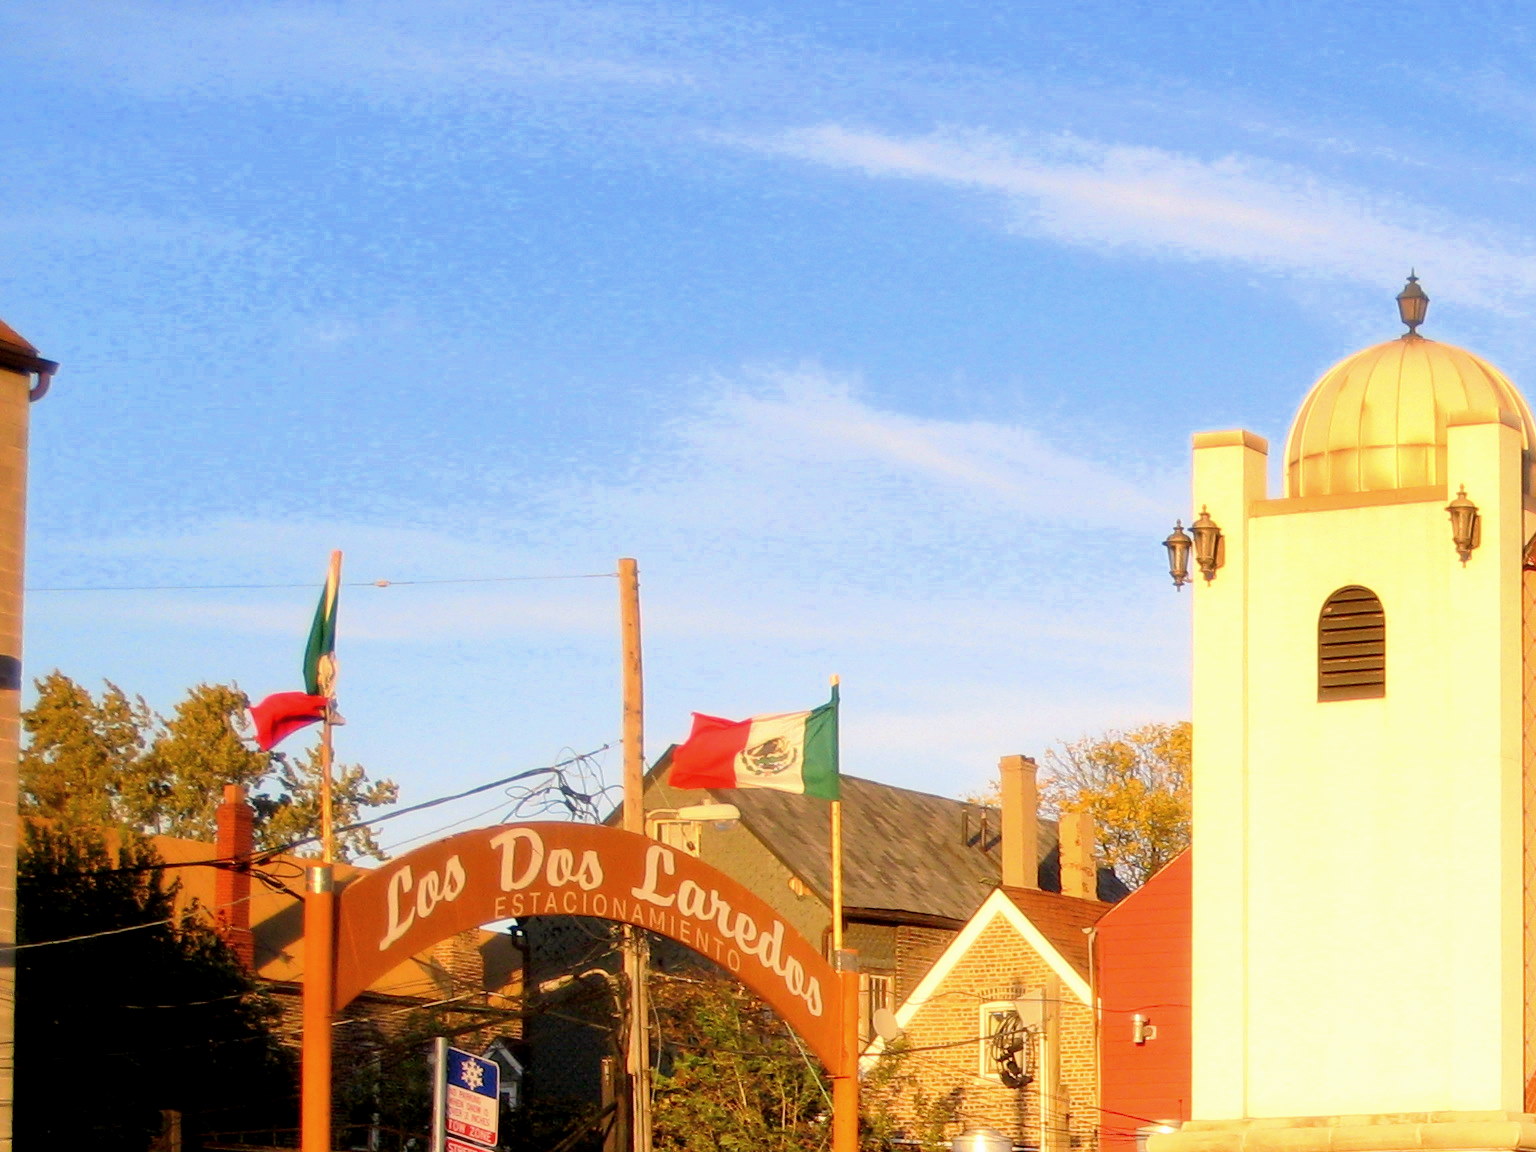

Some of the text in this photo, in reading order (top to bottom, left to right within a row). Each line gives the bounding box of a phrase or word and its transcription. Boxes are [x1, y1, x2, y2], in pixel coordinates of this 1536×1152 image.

[379, 827, 824, 1017] Los Dos Laredos
[494, 893, 742, 972] ESTACIONAMIENTO
[449, 1119, 492, 1143] TOW ZONE
